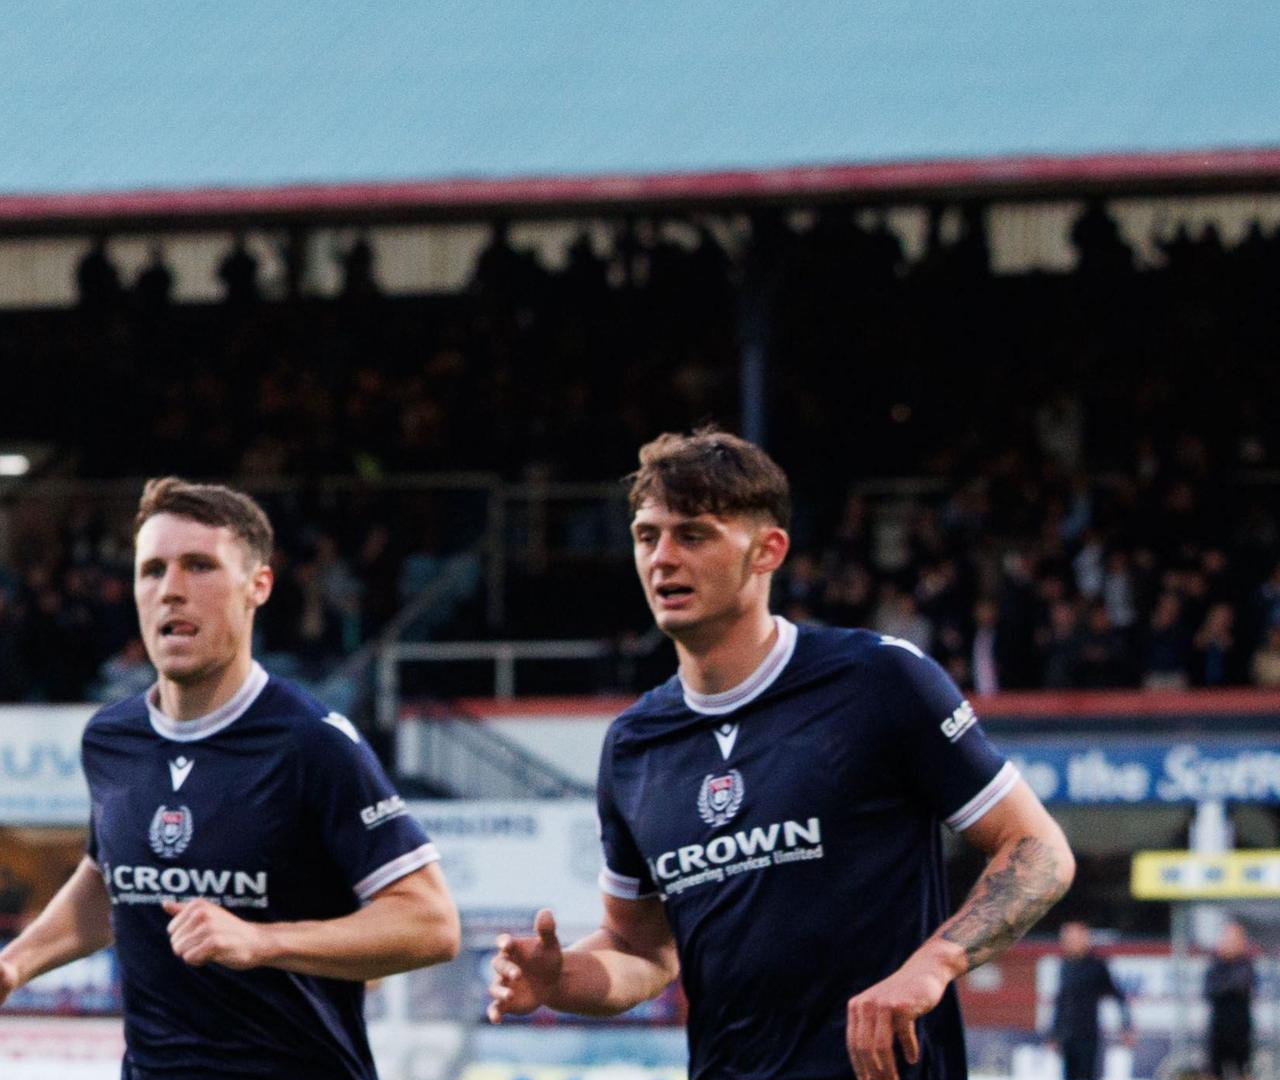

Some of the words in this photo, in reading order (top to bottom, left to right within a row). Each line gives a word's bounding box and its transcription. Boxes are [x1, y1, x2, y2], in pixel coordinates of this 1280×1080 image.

[656, 817, 821, 880] CROWN
[113, 865, 268, 895] CROWN
[726, 855, 771, 876] services
